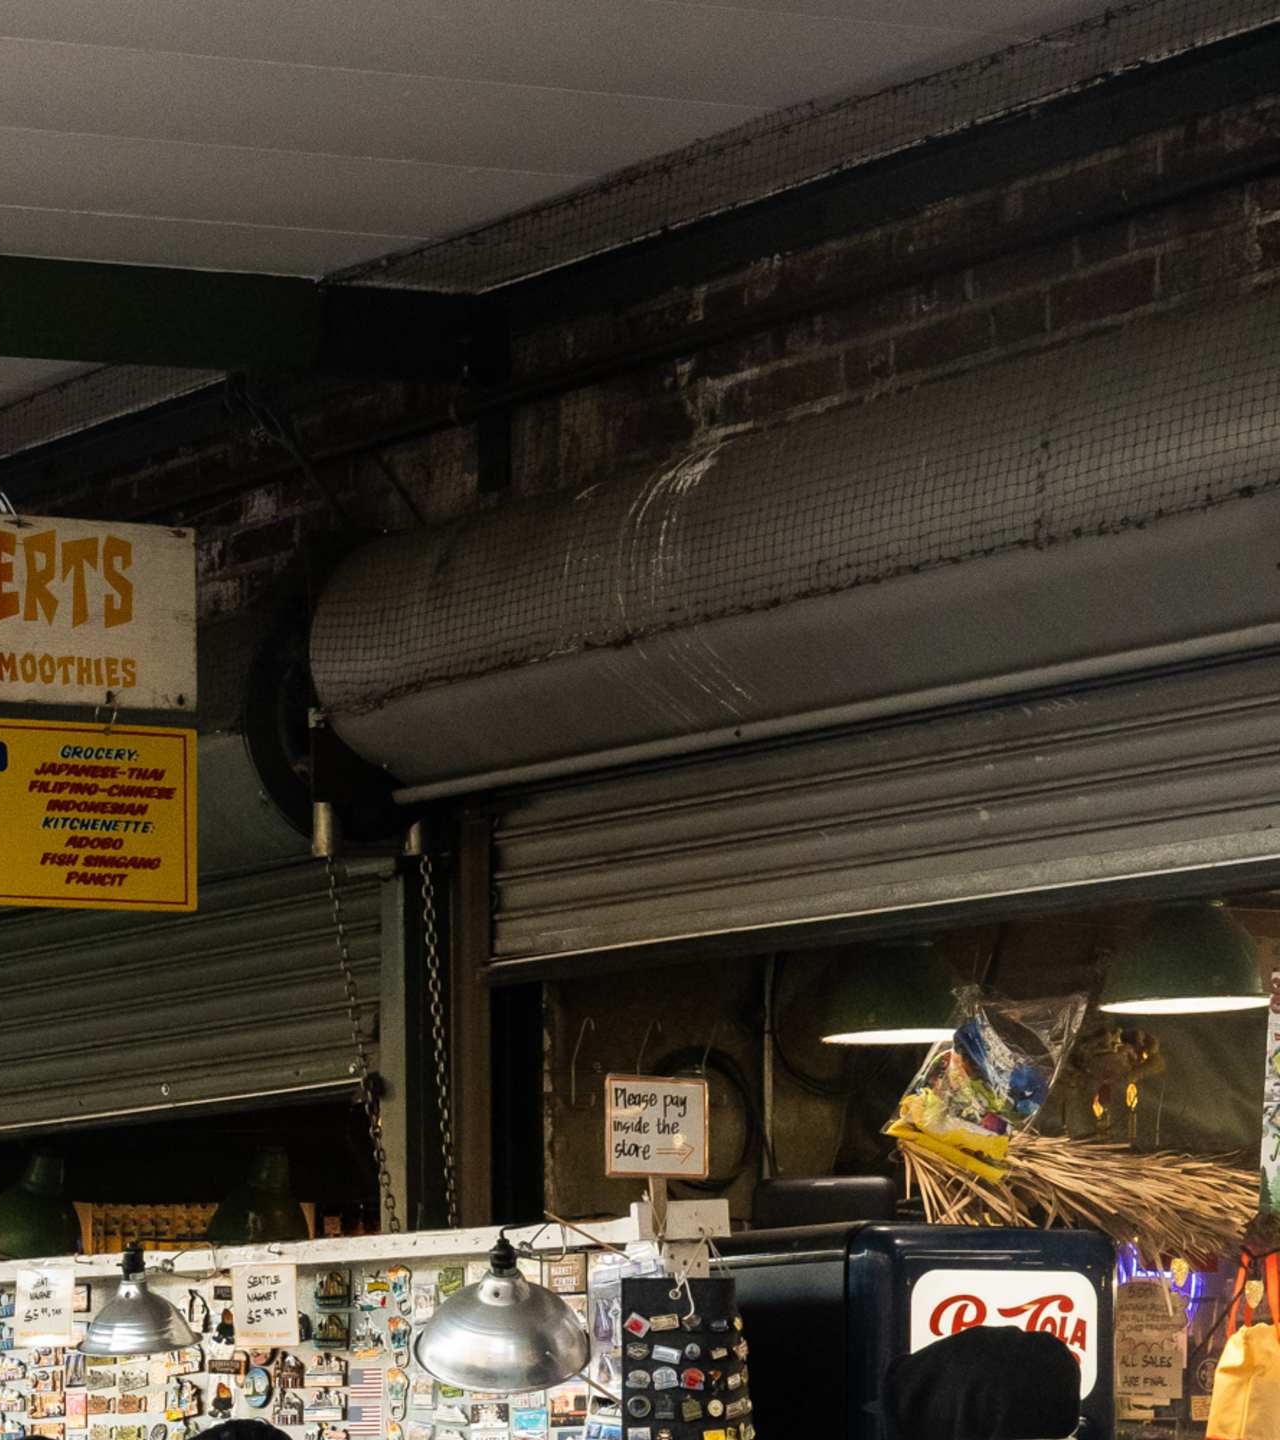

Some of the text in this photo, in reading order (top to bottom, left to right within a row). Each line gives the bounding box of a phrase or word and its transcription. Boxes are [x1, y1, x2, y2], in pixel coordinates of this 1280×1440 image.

[59, 744, 140, 762] GROCERY:
[45, 798, 150, 817] INDONESIAN
[63, 835, 125, 851] ADOBO
[39, 851, 81, 868] FISH
[64, 870, 129, 888] PANCIT
[614, 1087, 689, 1118] Please pay
[612, 1115, 681, 1136] inside the
[613, 1138, 652, 1161] store
[247, 1274, 282, 1290] SEATTLE
[1141, 1355, 1174, 1369] SALES
[1122, 1375, 1169, 1388] ARE FINAL
